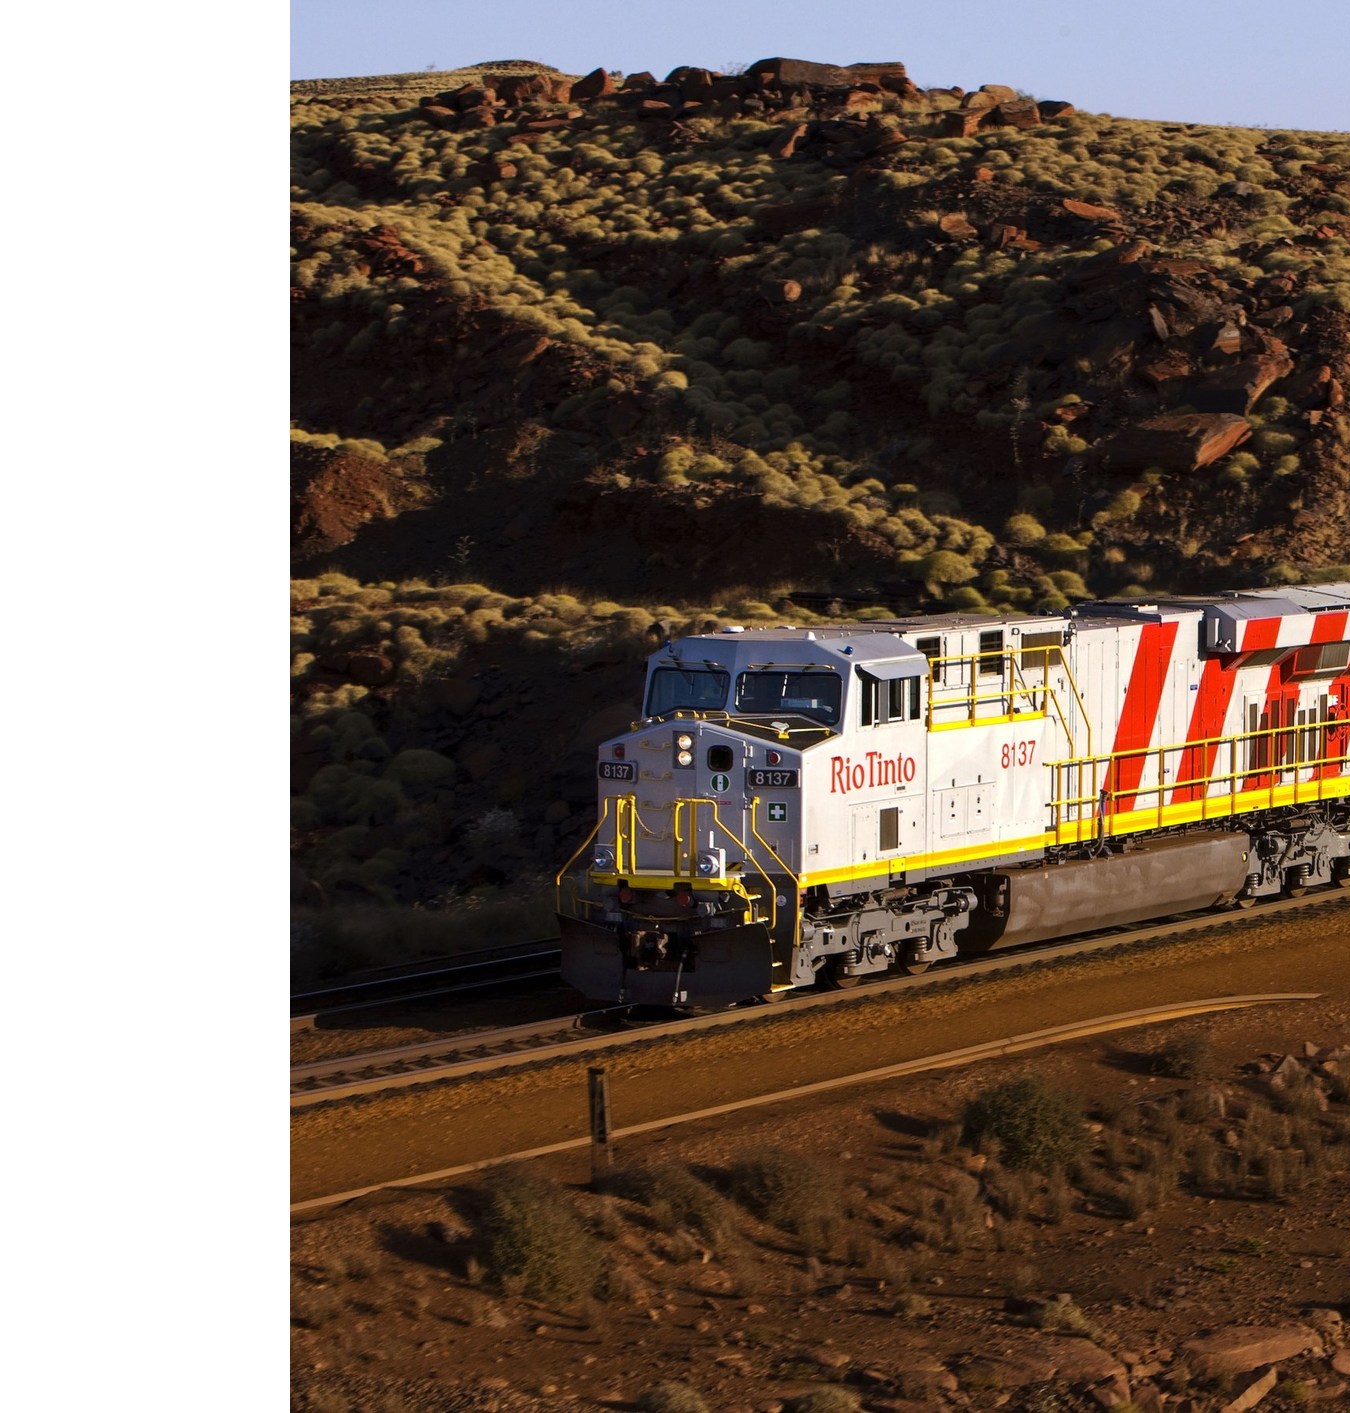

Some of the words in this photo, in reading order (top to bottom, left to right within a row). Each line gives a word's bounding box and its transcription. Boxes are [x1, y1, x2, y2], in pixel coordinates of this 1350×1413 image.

[1001, 740, 1036, 769] 8137
[604, 765, 630, 779] 8137
[755, 771, 791, 786] 8137
